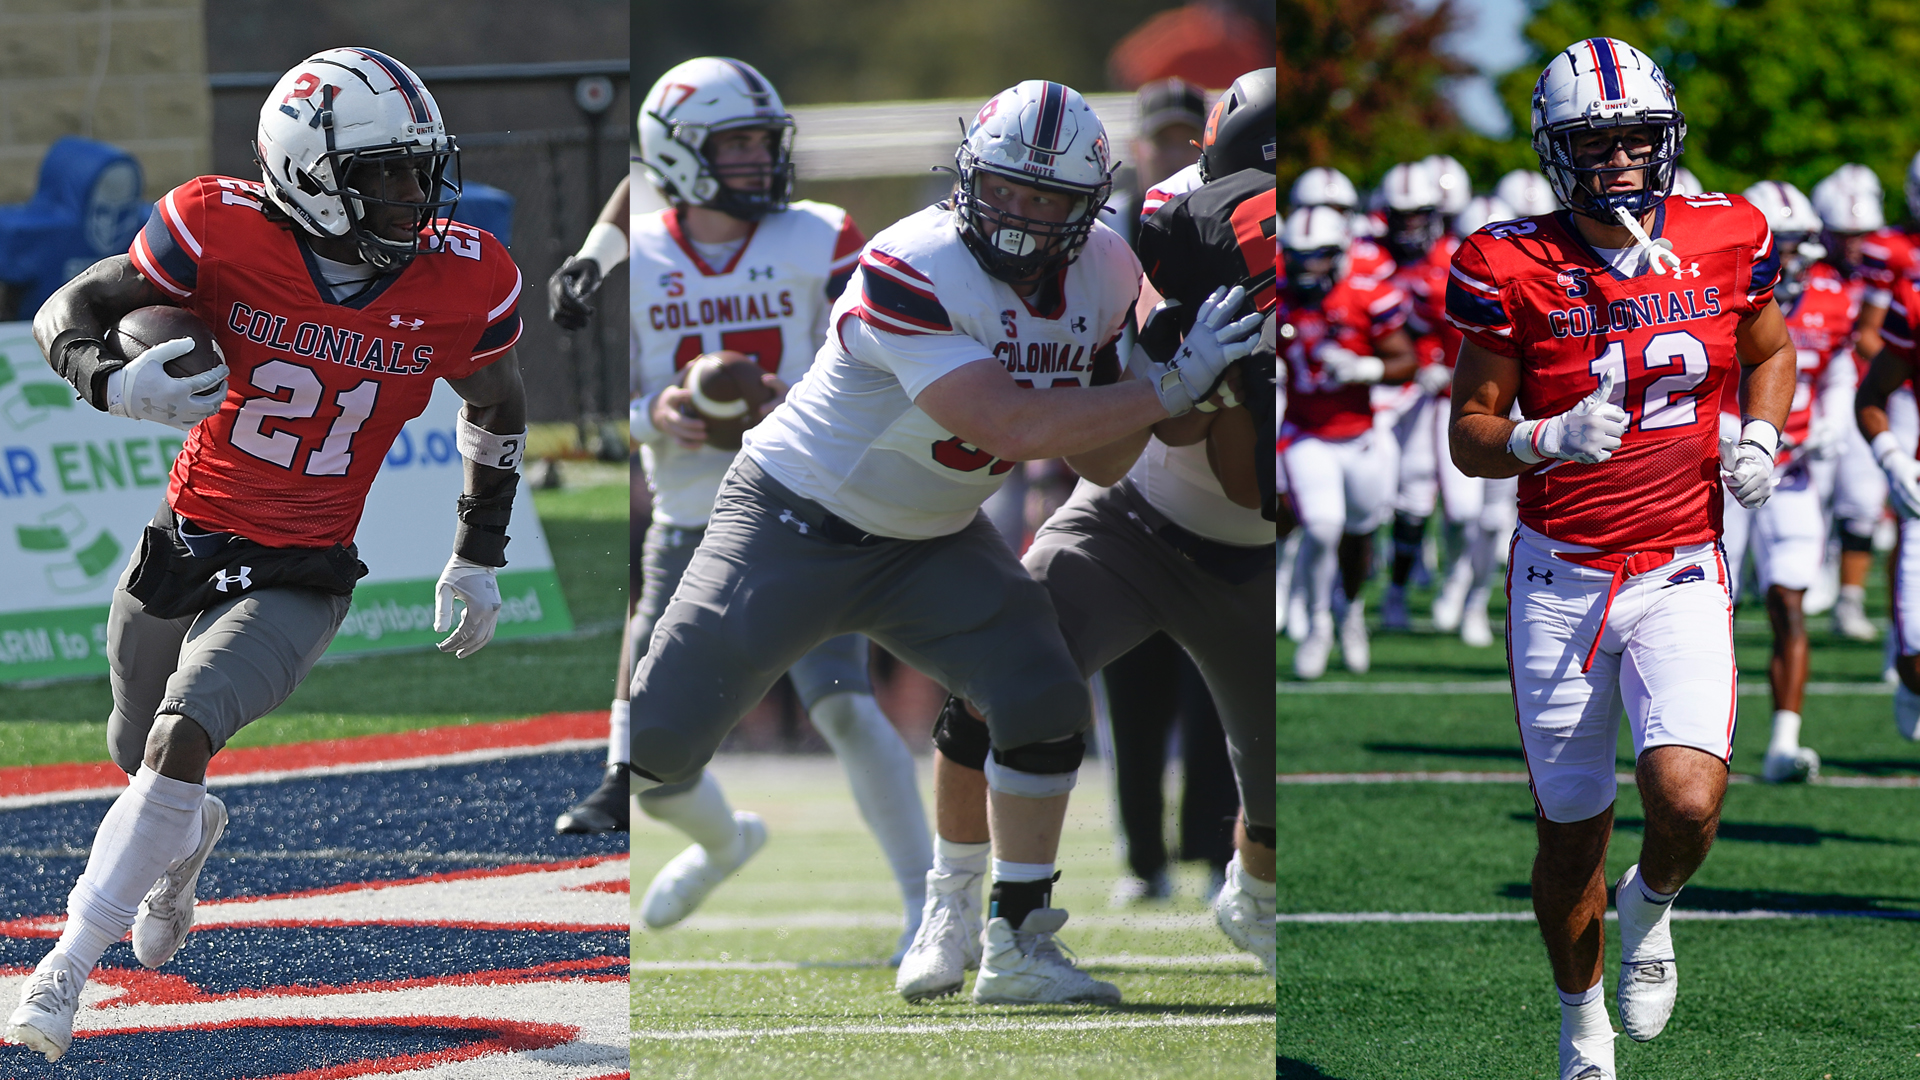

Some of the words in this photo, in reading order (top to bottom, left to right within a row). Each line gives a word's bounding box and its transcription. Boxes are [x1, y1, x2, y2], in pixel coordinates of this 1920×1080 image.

[278, 72, 343, 130] 21
[659, 82, 697, 119] 17
[1604, 102, 1629, 111] UNITE
[416, 125, 435, 135] UNITE
[1023, 162, 1056, 178] UNITE
[650, 290, 794, 331] COLONIALS
[1548, 286, 1722, 339] COLONIALS
[227, 301, 434, 375] COLONIALS
[1588, 329, 1711, 434] 12
[228, 357, 382, 478] 21
